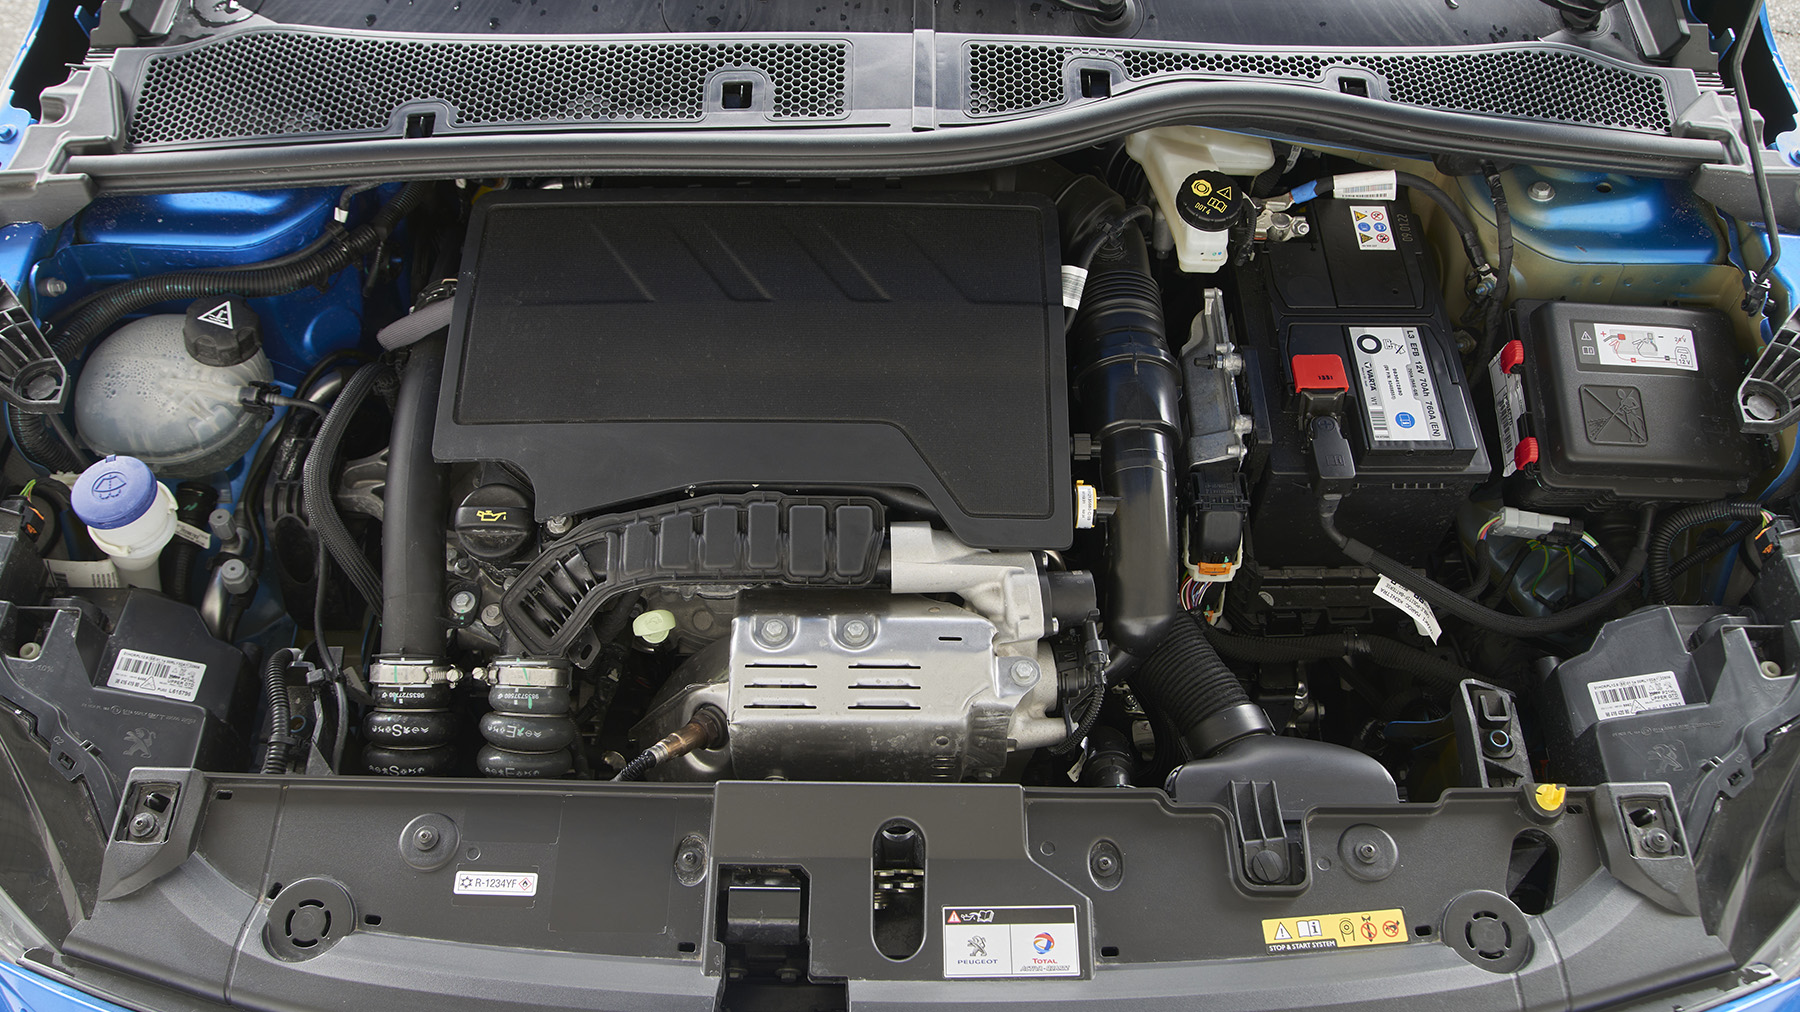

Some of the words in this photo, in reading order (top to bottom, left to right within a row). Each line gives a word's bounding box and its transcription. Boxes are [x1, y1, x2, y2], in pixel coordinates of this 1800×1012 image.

[1195, 202, 1207, 212] DOT
[1407, 330, 1415, 339] L3
[1410, 343, 1419, 356] EFB
[1415, 361, 1424, 374] 12V
[1366, 369, 1377, 391] VARTA
[1420, 378, 1429, 397] 70Ah
[1426, 401, 1436, 420] 760A
[1430, 421, 1440, 437] (EN)
[475, 878, 517, 888] R-1234YF
